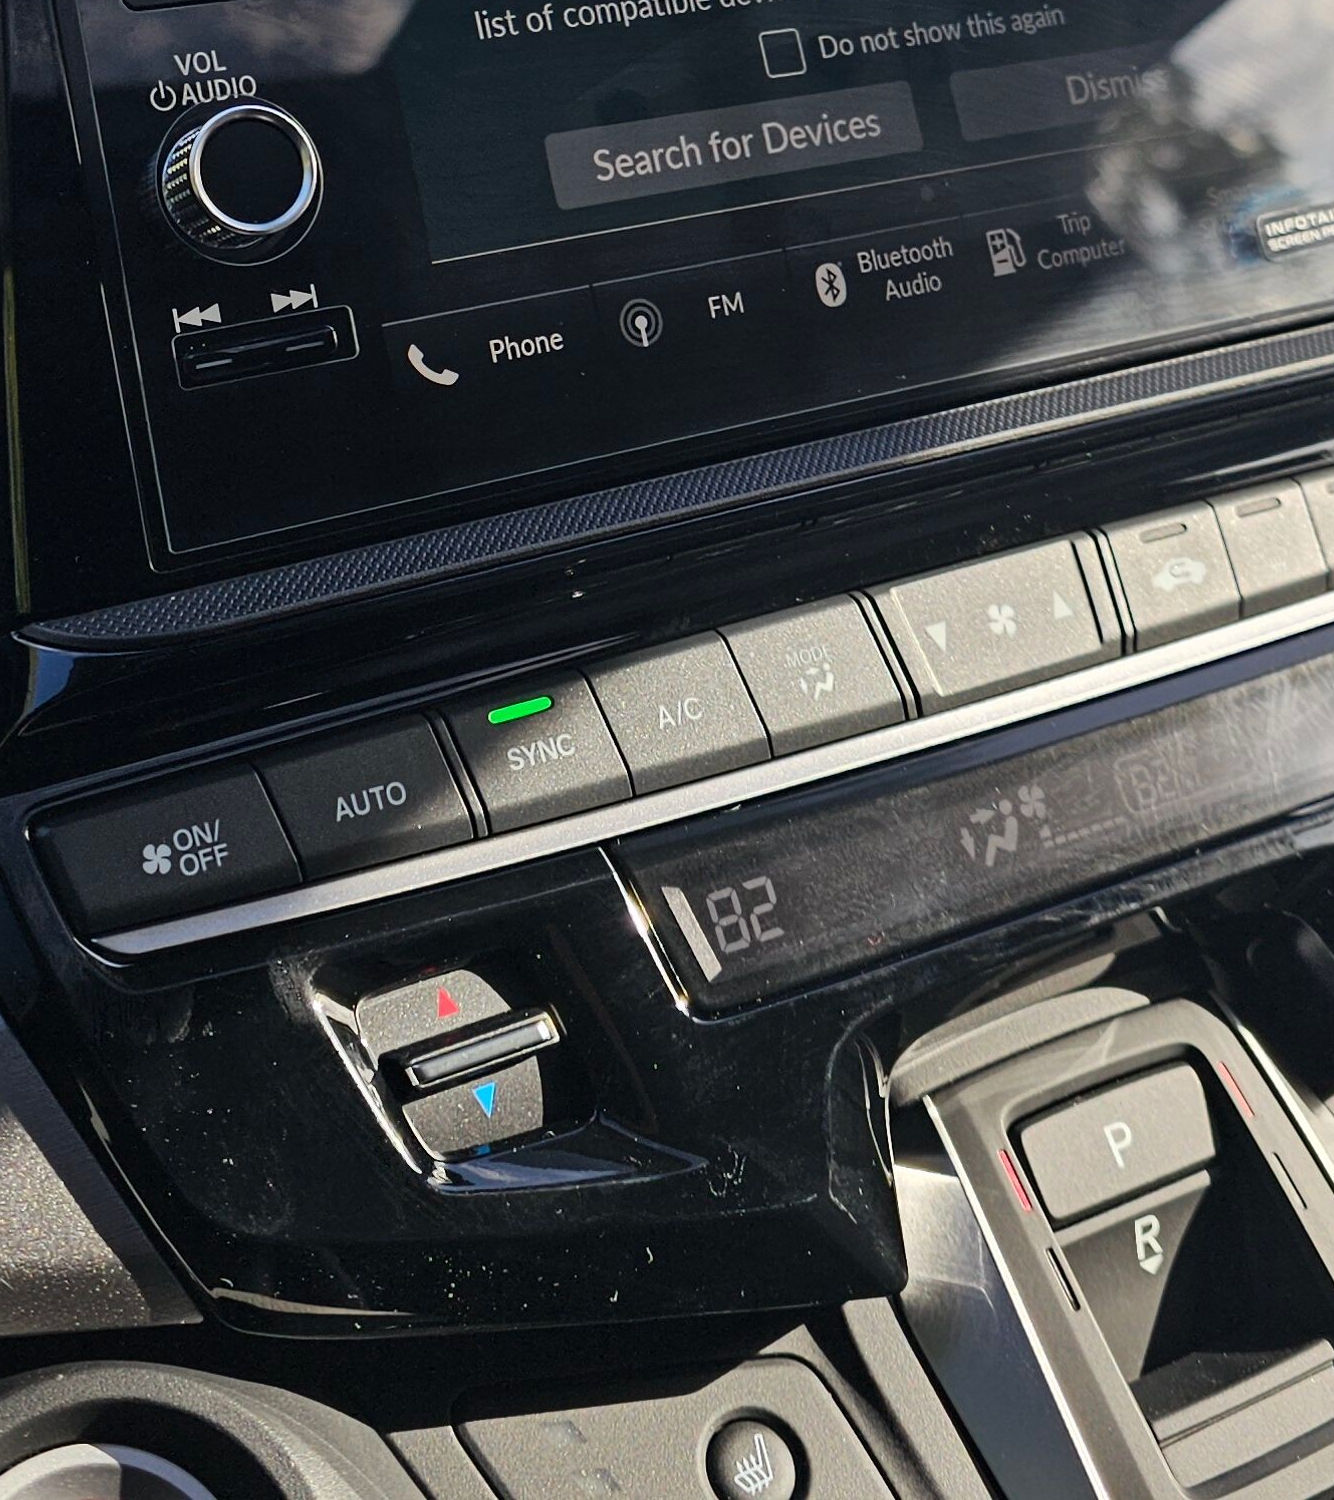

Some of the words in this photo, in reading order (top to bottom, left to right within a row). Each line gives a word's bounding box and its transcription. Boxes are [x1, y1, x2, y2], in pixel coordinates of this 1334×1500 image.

[473, 8, 521, 40] list
[525, 2, 556, 34] of
[817, 33, 855, 59] Do
[859, 26, 901, 54] not
[903, 21, 962, 48] show
[965, 11, 1007, 38] this
[1010, 3, 1066, 35] again
[173, 49, 228, 76] VOL
[181, 74, 258, 106] AUDIO
[592, 135, 703, 183] Search
[707, 129, 754, 163] for
[761, 111, 883, 156] Devices
[1056, 211, 1092, 236] Trip
[1267, 228, 1323, 253] SCREEN
[856, 236, 955, 275] Bluetooth
[1037, 238, 1126, 270] Computer
[884, 272, 943, 302] Audio
[707, 292, 745, 320] FM
[488, 330, 565, 364] Phone
[656, 694, 706, 731] A/C
[506, 731, 577, 773] SYNC
[334, 779, 408, 823] AUTO
[171, 818, 223, 852] ON/
[178, 841, 230, 879] OFF
[706, 875, 785, 954] 82
[1103, 1121, 1133, 1168] P
[1134, 1215, 1163, 1260] R
